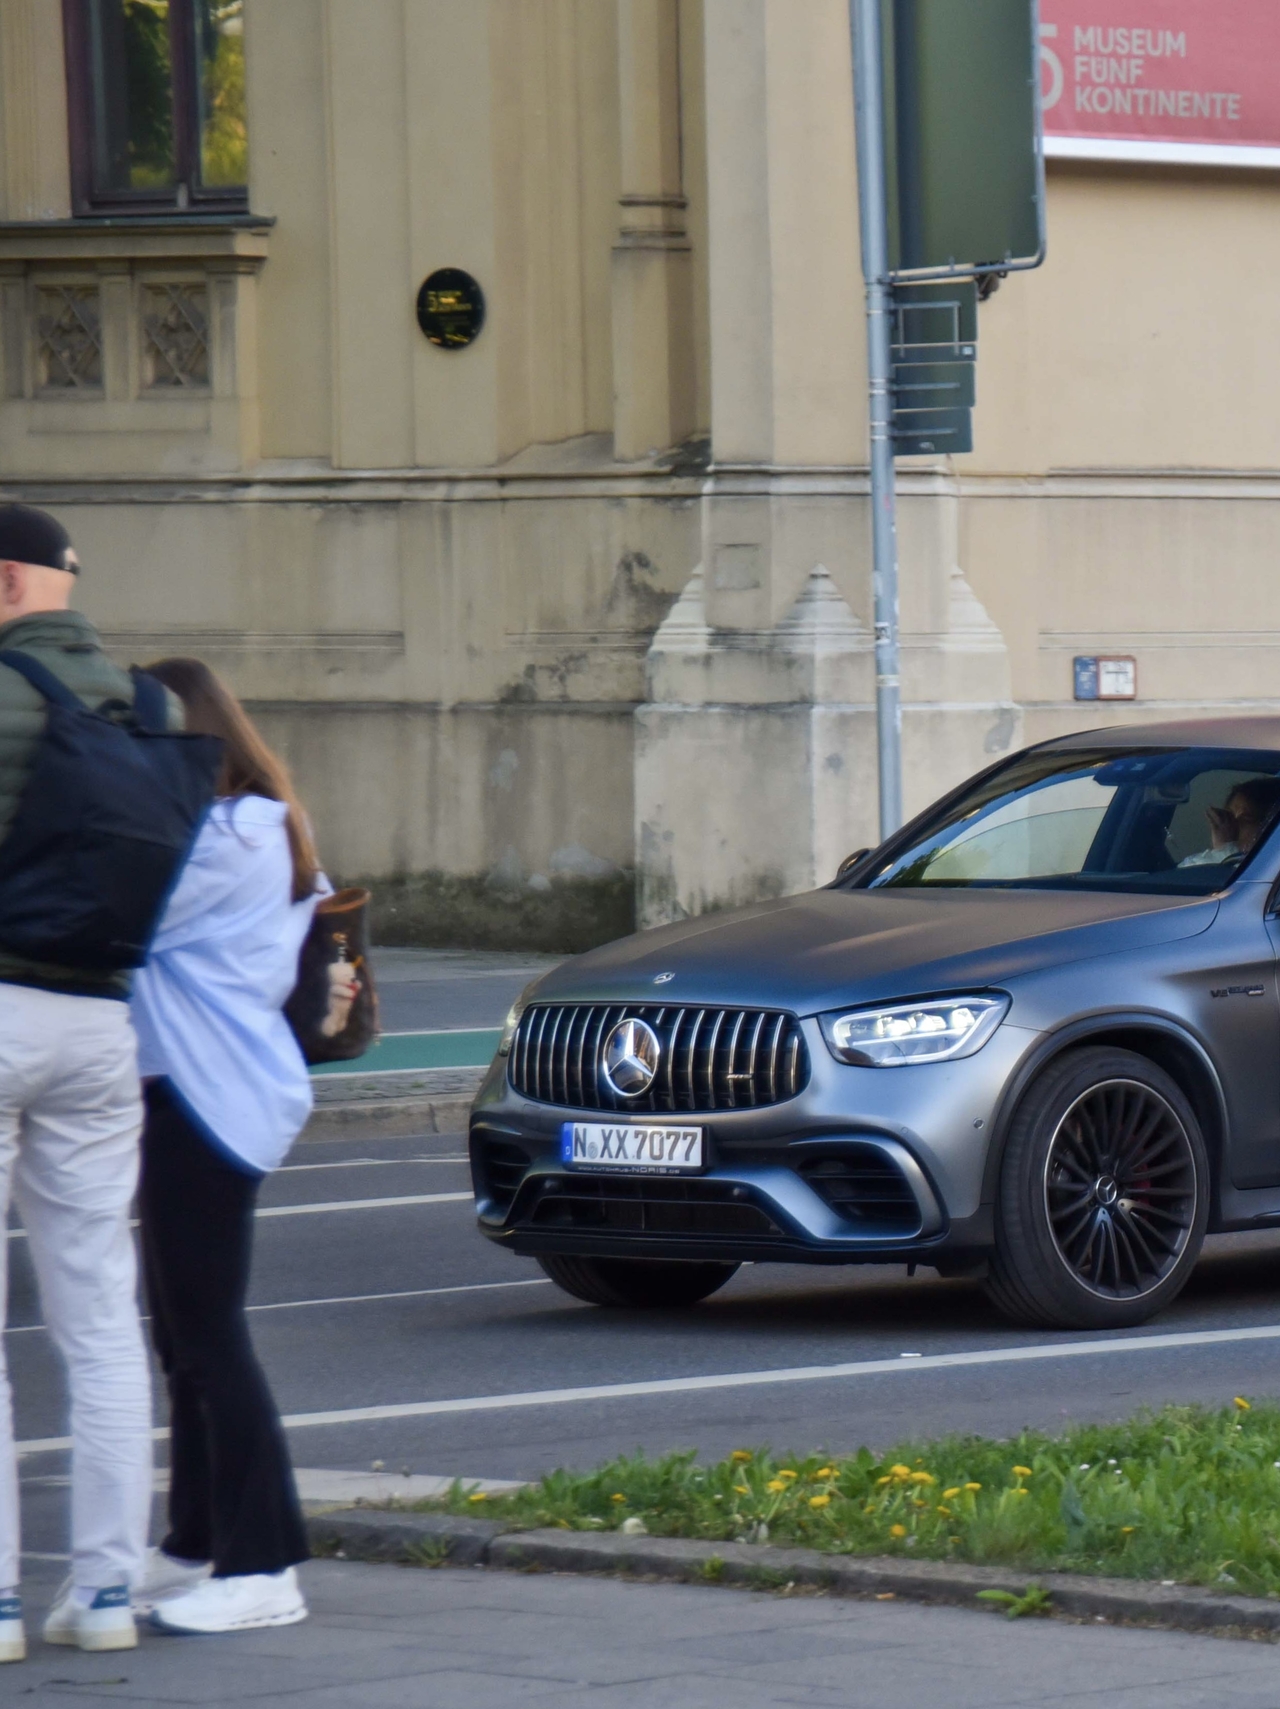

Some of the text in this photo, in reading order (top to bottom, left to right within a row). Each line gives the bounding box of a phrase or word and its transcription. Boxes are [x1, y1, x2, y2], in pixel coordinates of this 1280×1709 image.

[1074, 25, 1187, 57] MUSEUM
[1074, 55, 1144, 84] FÜNF
[1075, 85, 1240, 120] KONTINENTE
[574, 1127, 587, 1158] N
[634, 1130, 698, 1162] 7077
